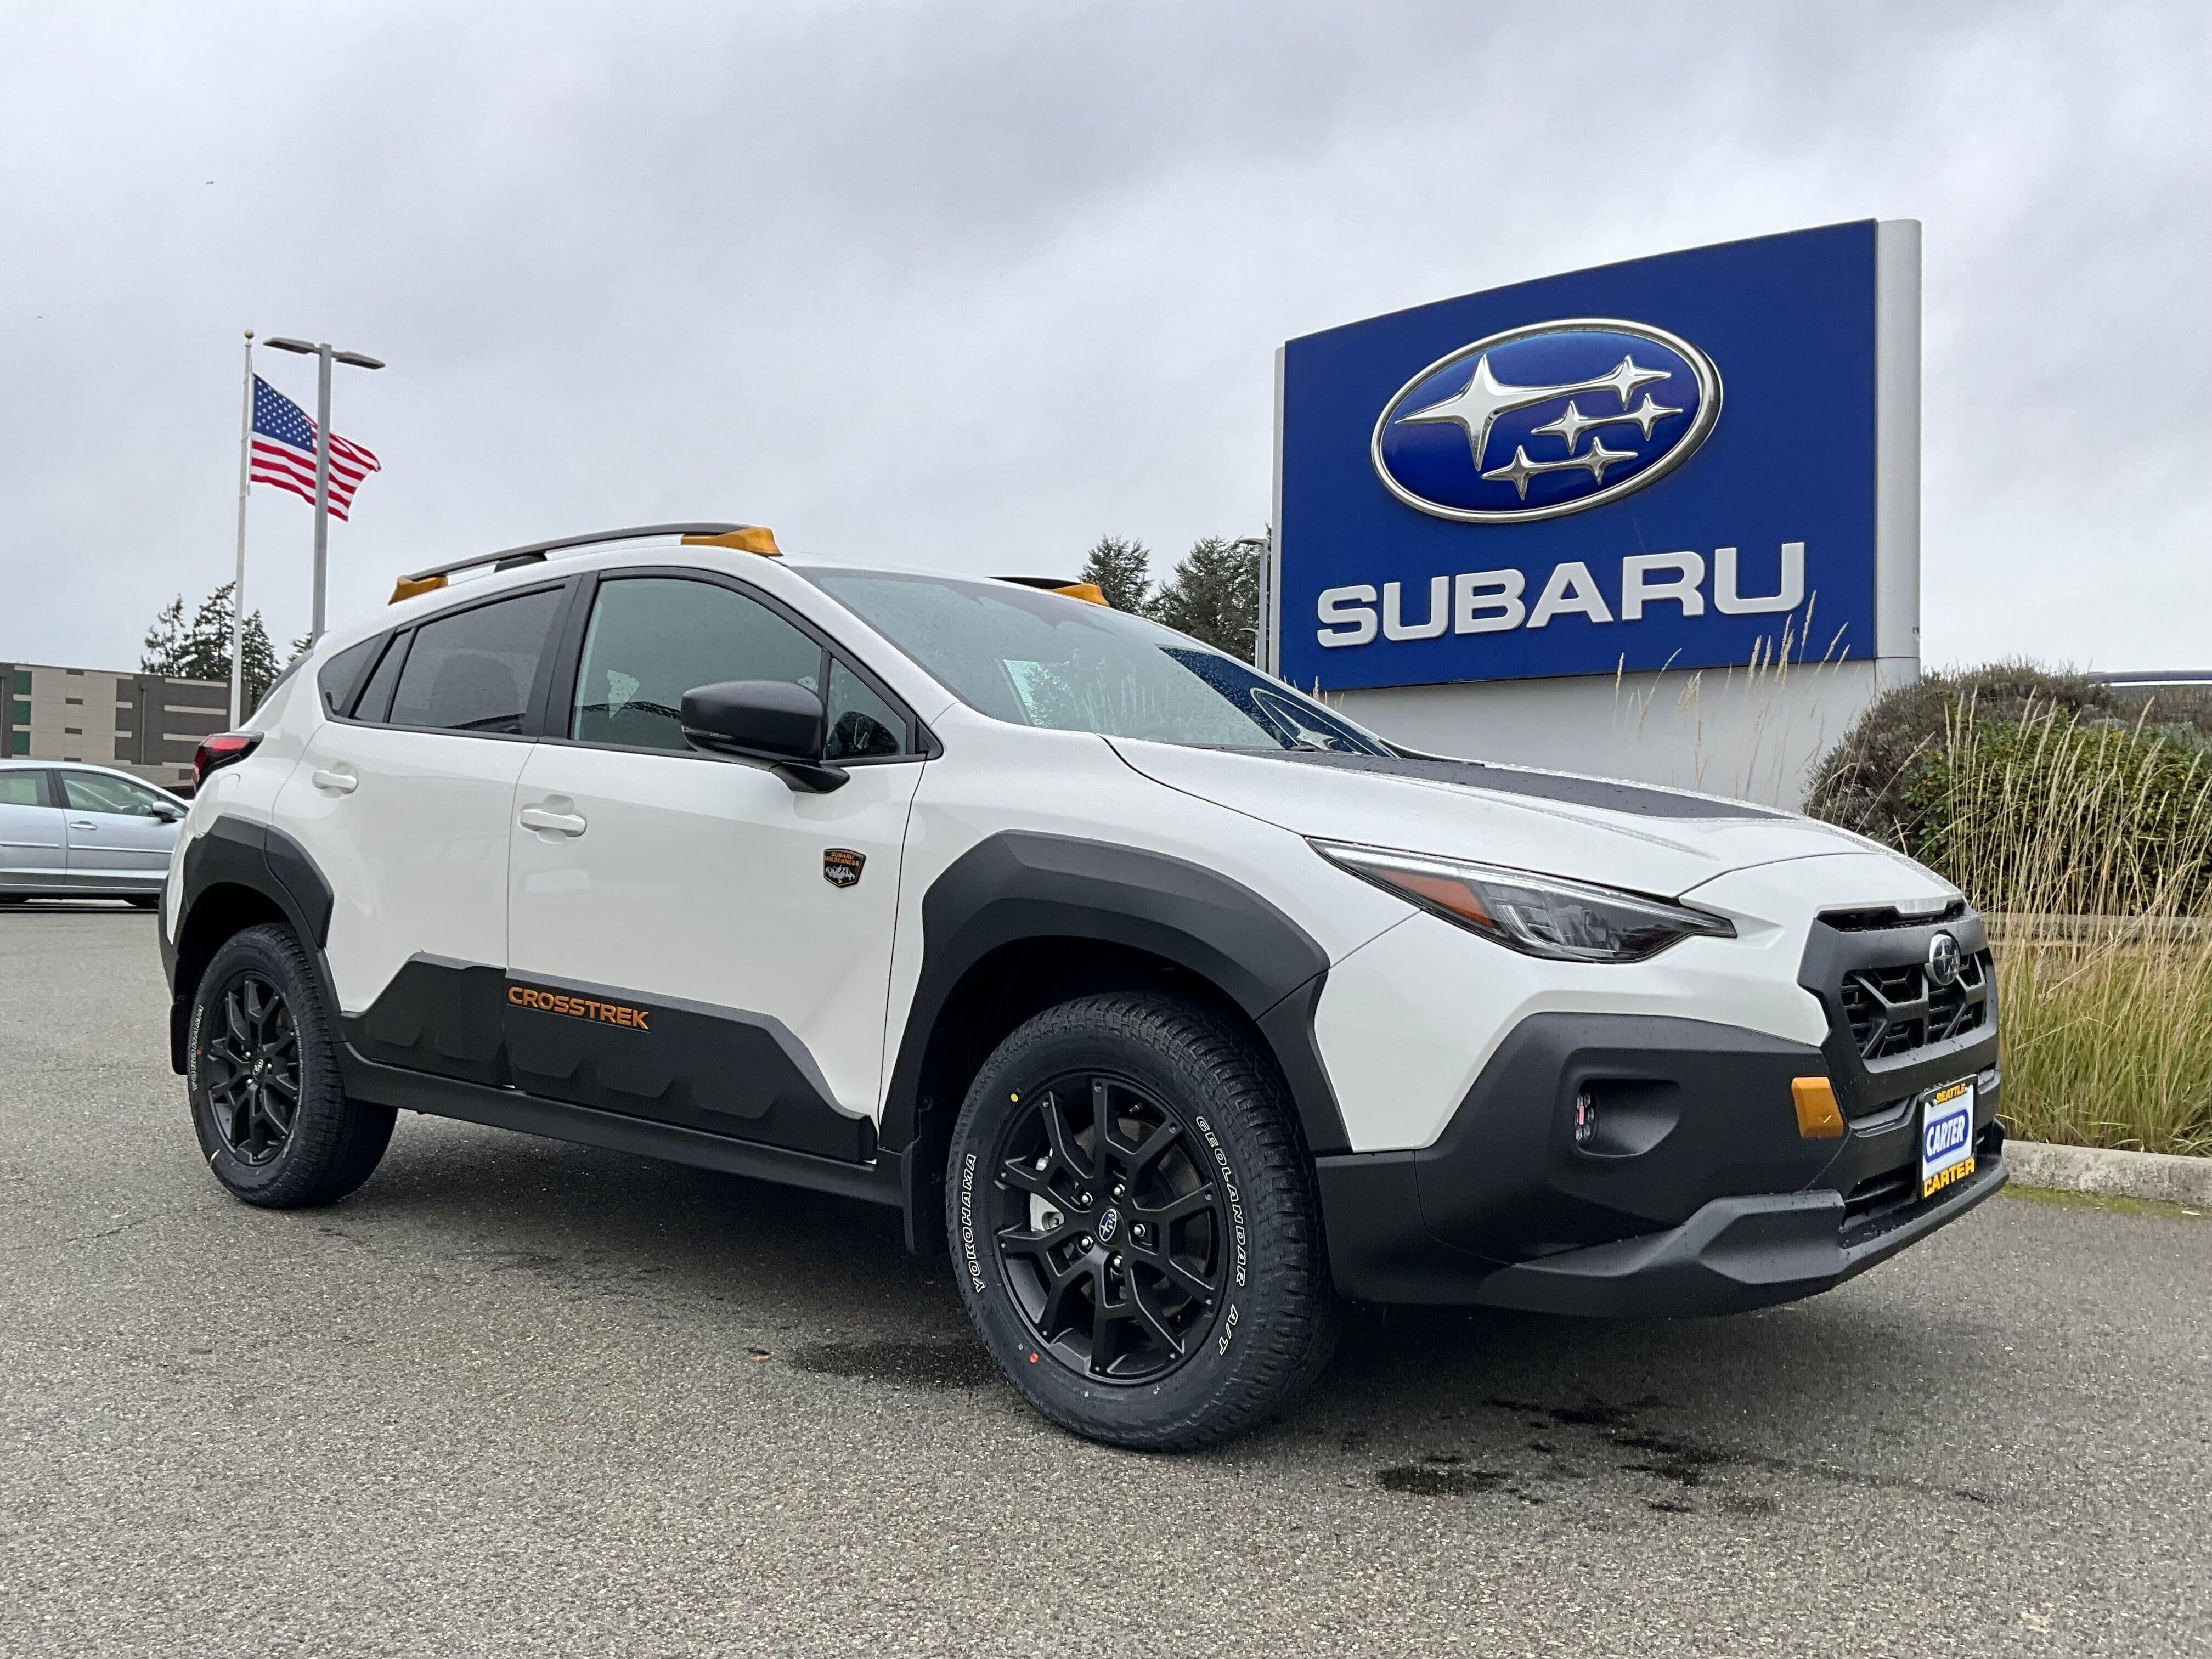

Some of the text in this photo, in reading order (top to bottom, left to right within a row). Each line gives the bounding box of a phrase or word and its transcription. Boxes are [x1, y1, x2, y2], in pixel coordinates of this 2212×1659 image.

[1317, 542, 1805, 648] SUBARU
[825, 856, 860, 866] WILDERNESS
[831, 851, 854, 860] SUBARU
[507, 986, 650, 1030] CROSSTREK
[1936, 1083, 1967, 1104] SEATTLE
[1926, 1115, 1966, 1157] CARTER
[1923, 1158, 1975, 1198] CARTER
[961, 1153, 986, 1294] YOKOHAMA
[1195, 1116, 1247, 1356] GEOLANDAR A/T
